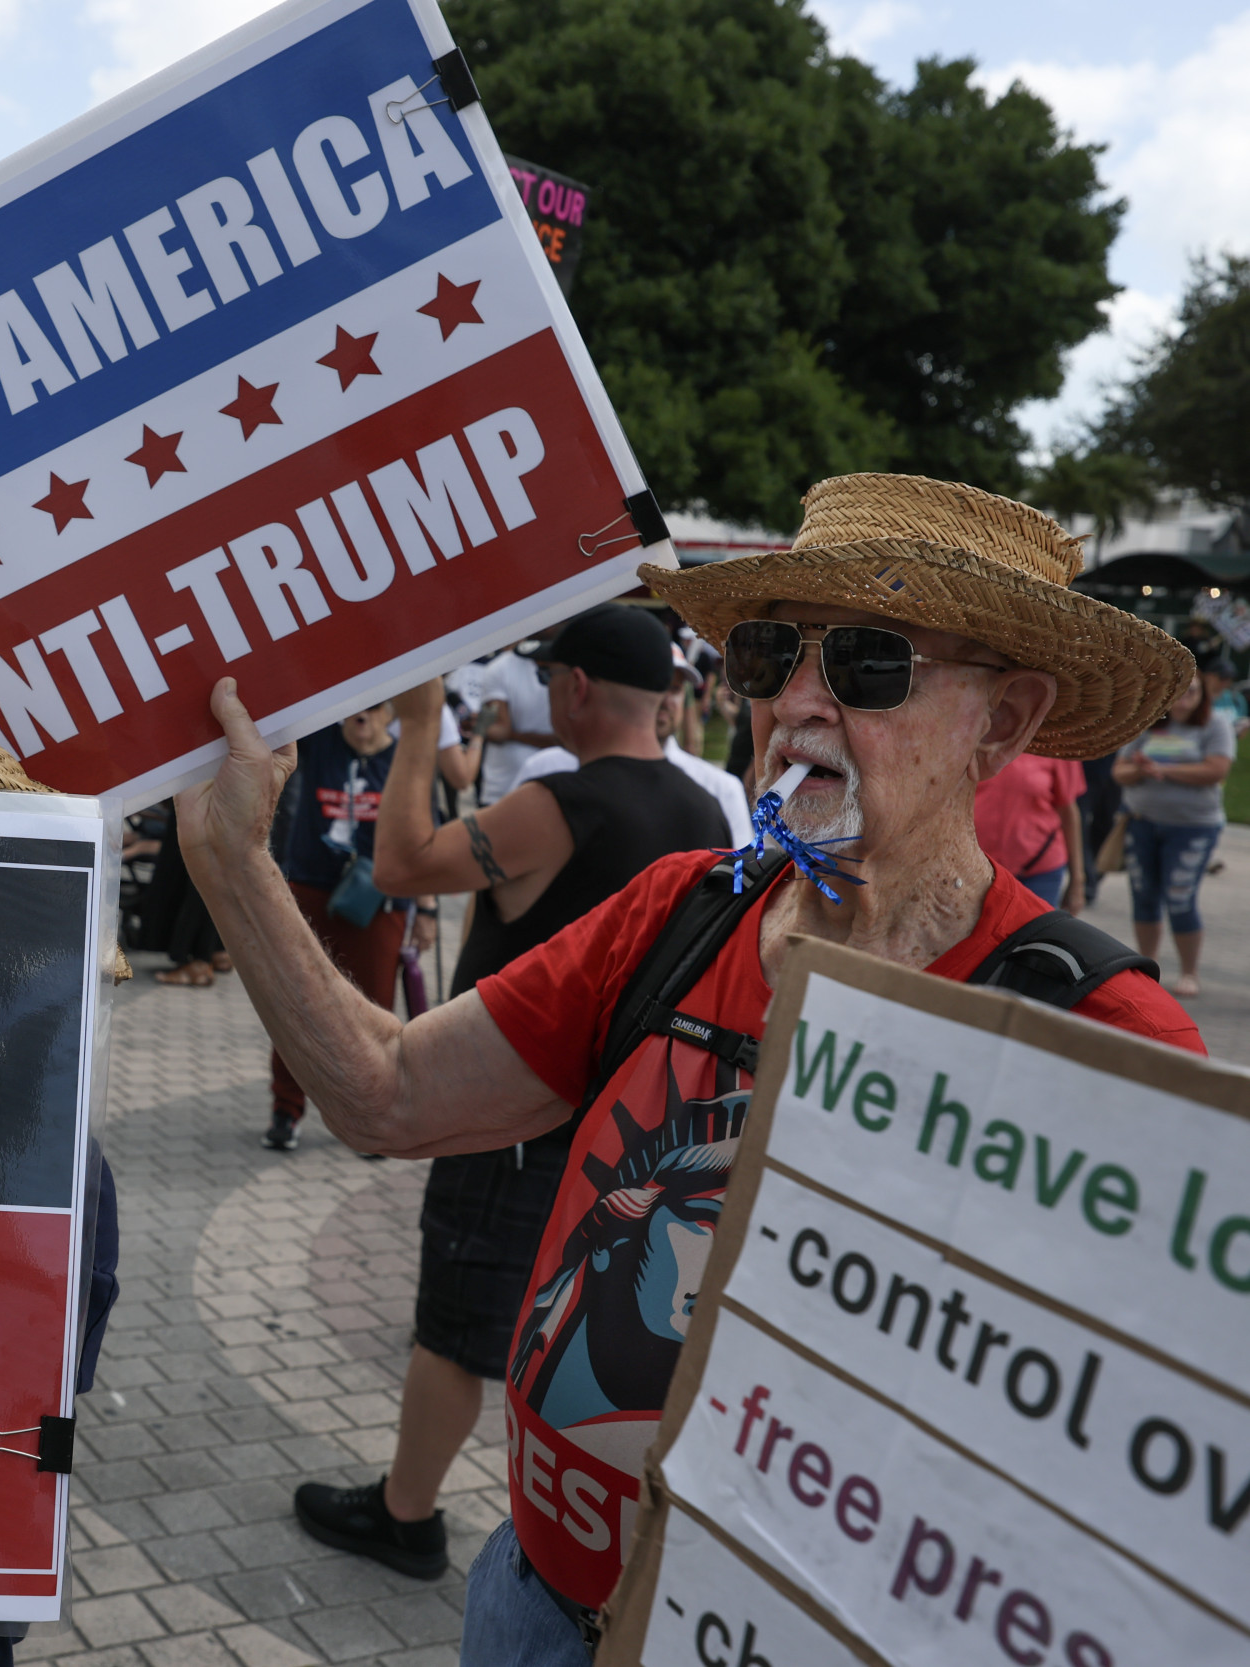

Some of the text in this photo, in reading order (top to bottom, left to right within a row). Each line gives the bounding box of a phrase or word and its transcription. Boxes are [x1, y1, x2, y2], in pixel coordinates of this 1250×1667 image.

[537, 179, 586, 228] OUR
[533, 219, 567, 264] CE
[670, 1017, 712, 1041] CAMELBAK
[791, 1018, 898, 1133] We
[916, 1072, 1141, 1238] have
